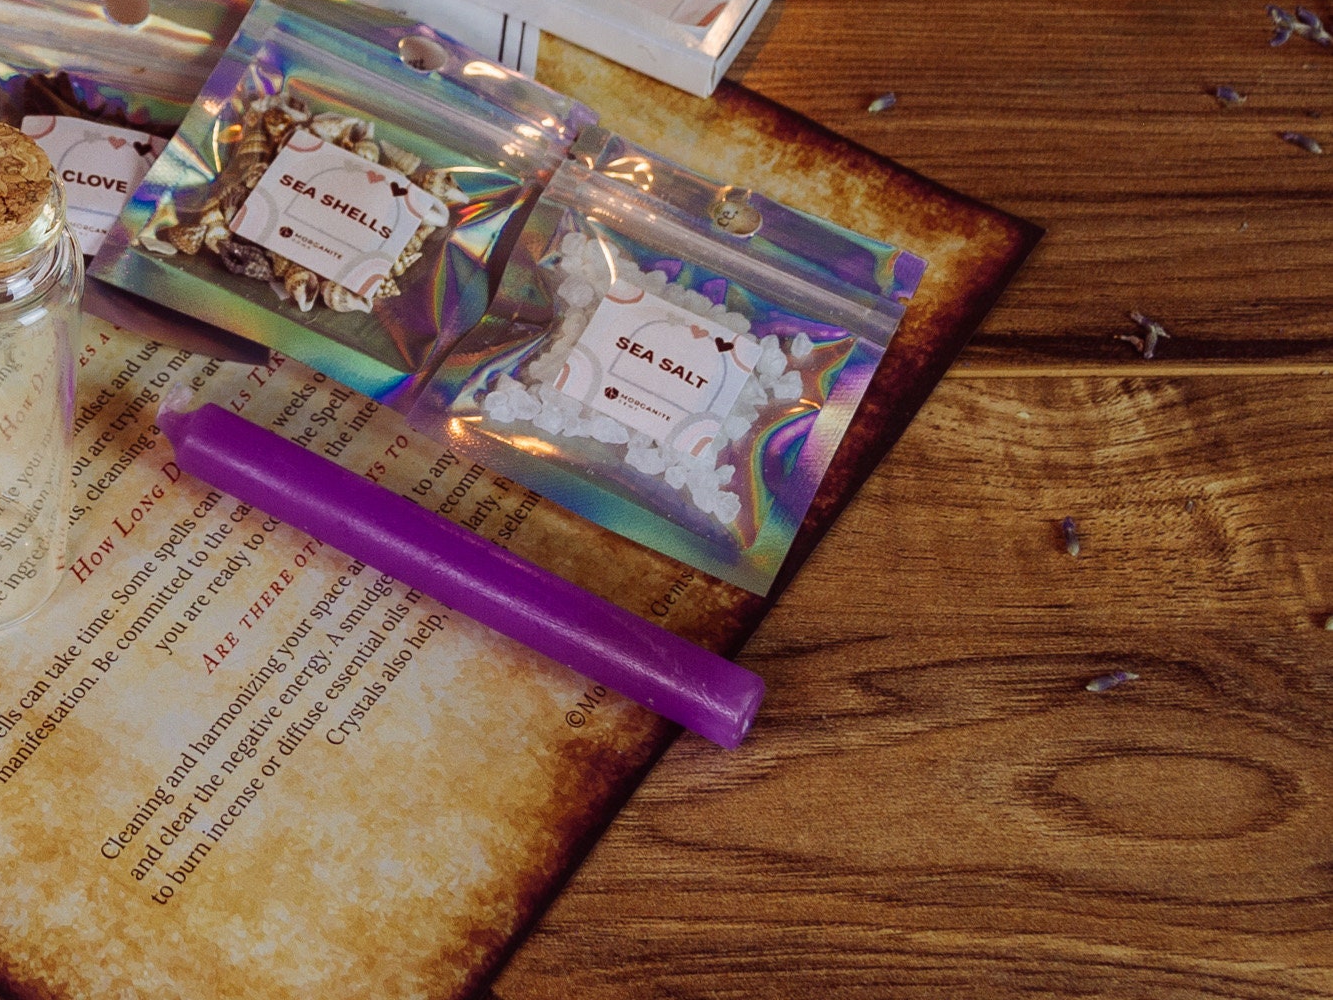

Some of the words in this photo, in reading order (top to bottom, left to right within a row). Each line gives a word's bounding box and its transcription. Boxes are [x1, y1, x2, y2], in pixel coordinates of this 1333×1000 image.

[62, 169, 128, 194] CLOVE
[279, 174, 316, 200] SEA
[320, 193, 393, 240] SHELLS
[295, 232, 343, 261] MORGANITE
[111, 359, 141, 390] and
[615, 336, 654, 365] SEA
[658, 357, 709, 390] SALT
[620, 393, 672, 423] MORGANITE
[88, 431, 115, 457] are
[112, 386, 160, 434] trying
[150, 371, 170, 389] to
[86, 437, 155, 502] cleansing
[19, 679, 51, 710] can
[44, 645, 82, 680] take
[77, 608, 119, 645] time.
[112, 561, 158, 606] Some
[154, 518, 197, 562] spells
[192, 491, 223, 519] can
[272, 382, 317, 430] weeks
[69, 535, 115, 584] HOW
[111, 483, 166, 538] LONG
[91, 650, 120, 673] Be
[116, 565, 194, 651] committed
[187, 549, 209, 568] to
[204, 522, 234, 550] the
[310, 388, 355, 427] Spell,
[155, 620, 188, 655] you
[184, 594, 211, 622] are
[207, 550, 252, 595] ready
[243, 533, 265, 552] to
[324, 431, 352, 458] the
[202, 631, 241, 675] ARE
[239, 569, 295, 631] THERE
[385, 434, 409, 460] TO
[650, 570, 695, 618] Gems
[100, 785, 176, 860] Cleaning
[166, 752, 199, 788] and
[188, 655, 287, 756] harmonizing
[278, 617, 314, 660] your
[309, 575, 353, 620] space
[411, 478, 433, 497] to
[429, 449, 461, 478] any
[326, 681, 387, 746] Crystals
[380, 648, 413, 683] also
[404, 612, 450, 650] help,
[130, 844, 164, 881] and
[159, 802, 199, 847] clear
[194, 773, 225, 804] the
[220, 705, 283, 775] negative
[278, 648, 333, 705] energy.
[325, 632, 346, 648] A
[339, 572, 395, 633] smudge
[150, 884, 175, 906] to
[166, 841, 212, 885] burn
[202, 776, 265, 842] incense
[261, 755, 282, 777] or
[278, 700, 329, 757] diffuse
[325, 630, 386, 700] essential
[381, 602, 411, 632] oils
